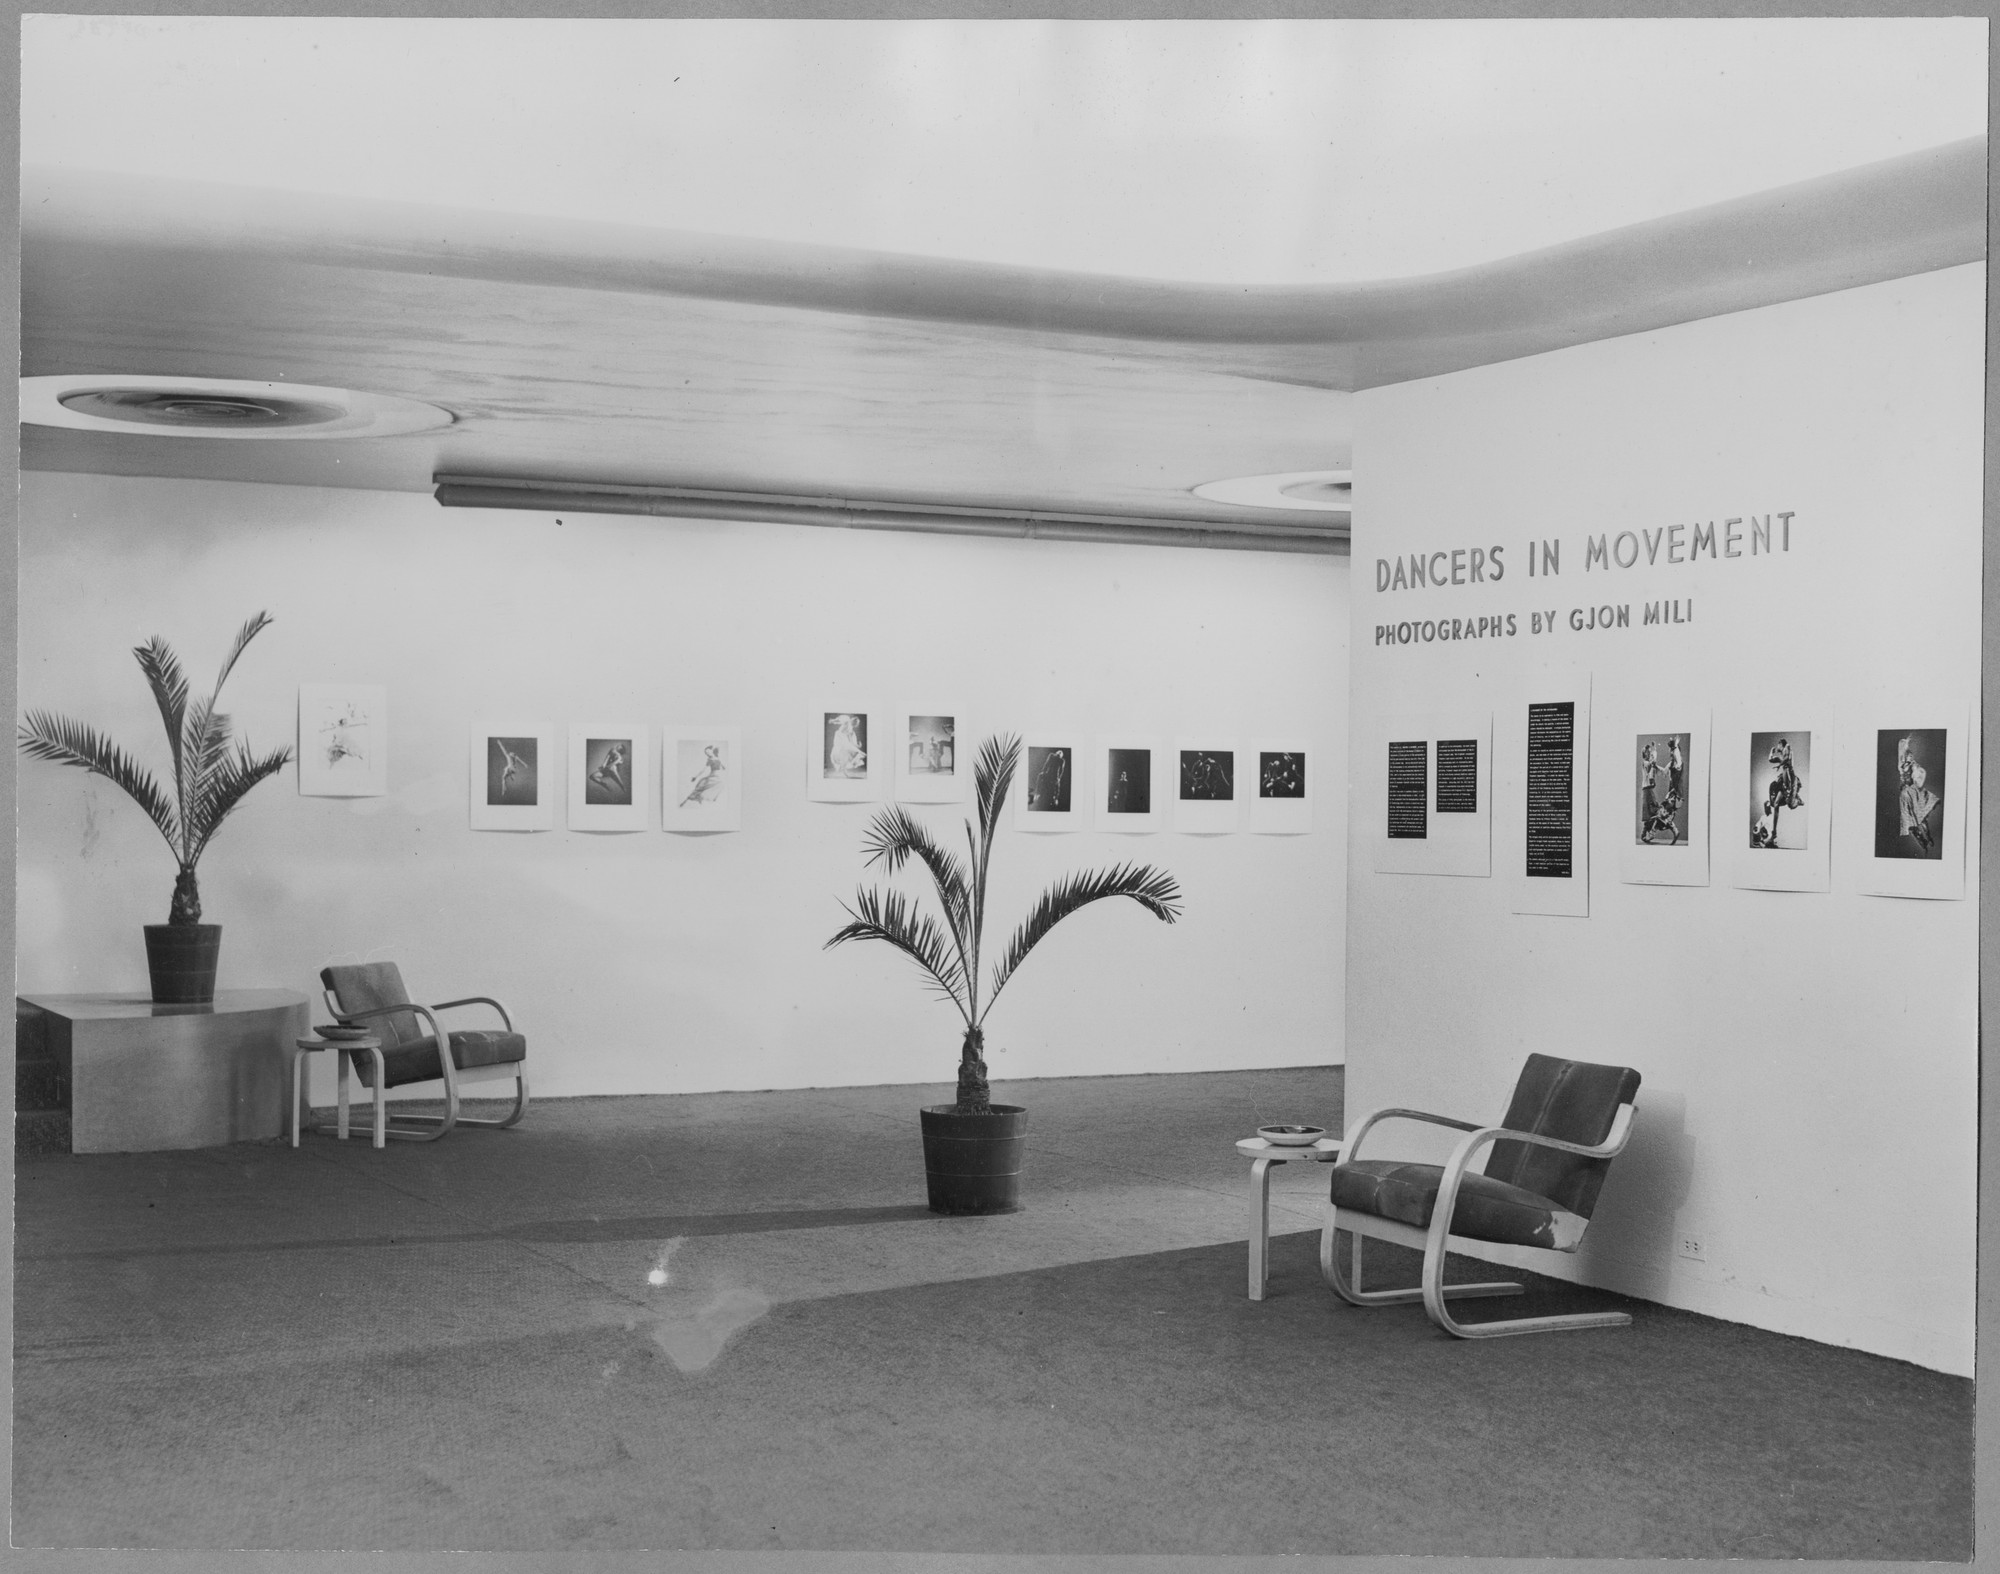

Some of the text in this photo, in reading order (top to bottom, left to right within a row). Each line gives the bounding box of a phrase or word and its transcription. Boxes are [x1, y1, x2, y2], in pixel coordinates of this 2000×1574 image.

[1377, 511, 1796, 593] DANCERS IN MOVEMENT
[1375, 598, 1693, 646] PHOTOGRAPHS BY GJON MILI
